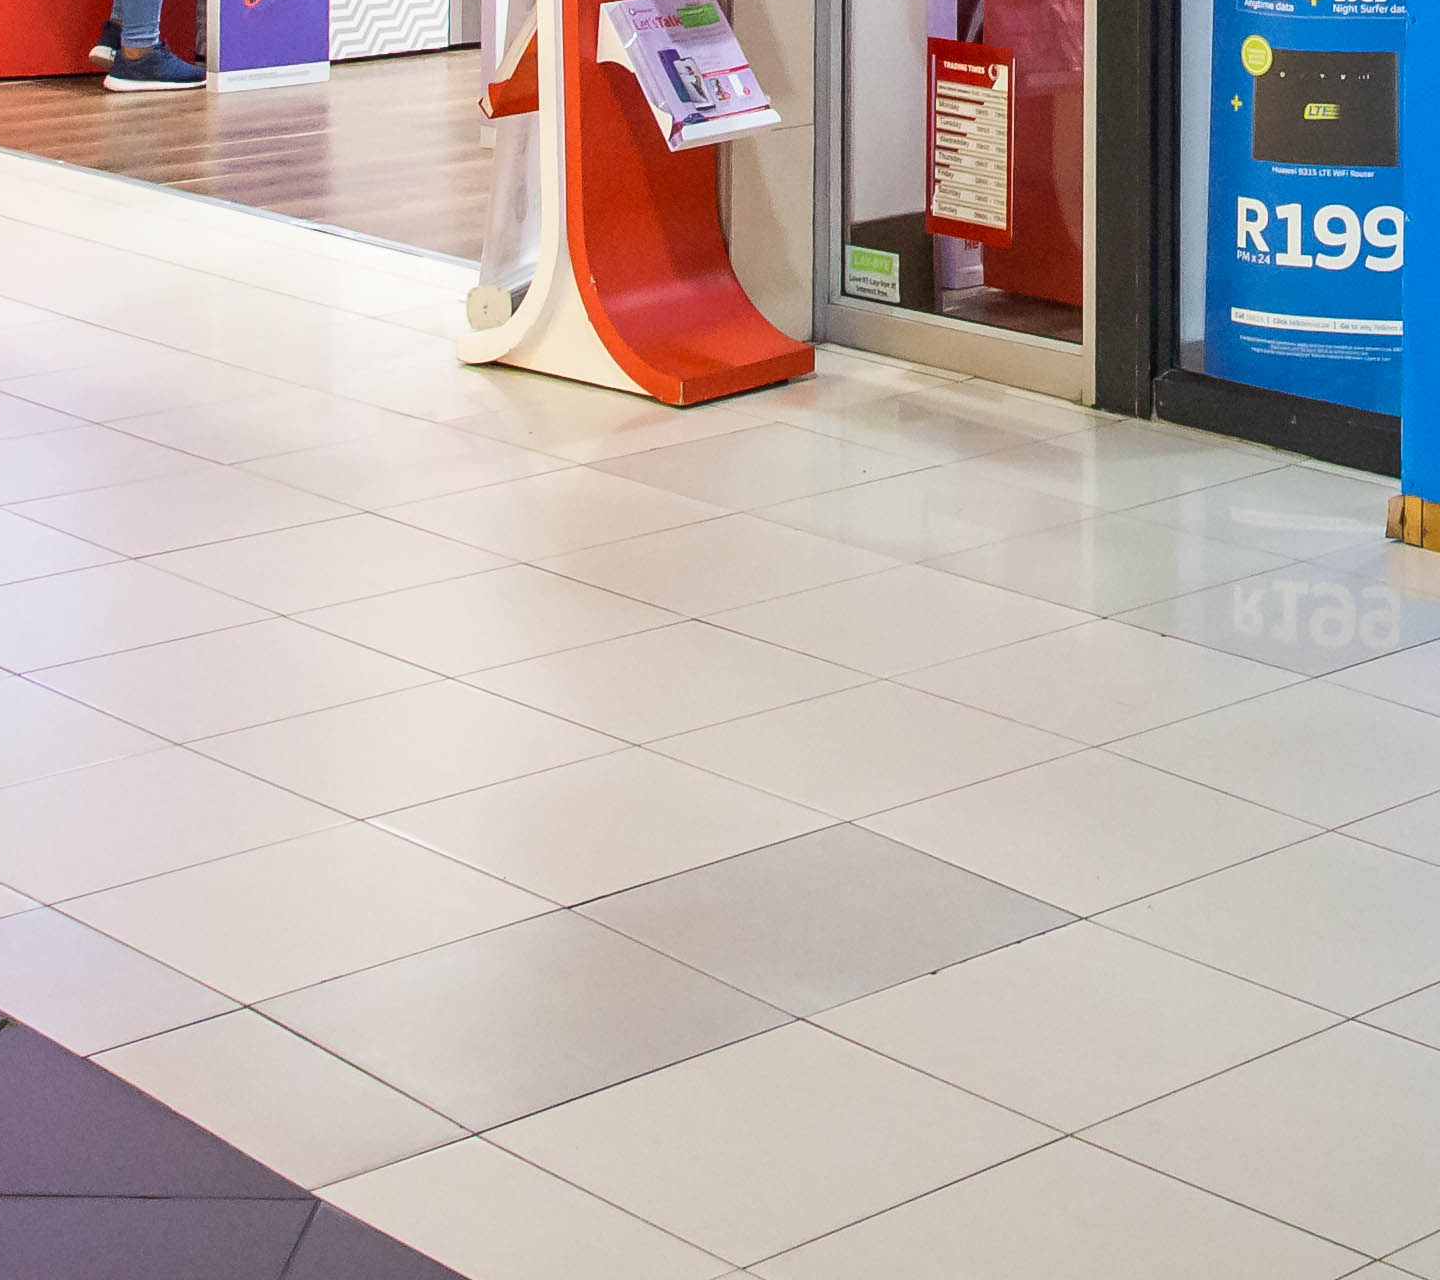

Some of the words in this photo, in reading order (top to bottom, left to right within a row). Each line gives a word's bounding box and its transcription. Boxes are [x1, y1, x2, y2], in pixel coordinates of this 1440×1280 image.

[1275, 1, 1295, 12] data
[1332, 3, 1358, 16] Night
[1360, 3, 1389, 14] Surfer
[1390, 3, 1408, 14] dat
[1306, 104, 1331, 118] LTE
[1318, 168, 1331, 177] LTE
[1349, 169, 1375, 178] Router
[1236, 195, 1405, 272] R199
[1257, 252, 1271, 265] 24
